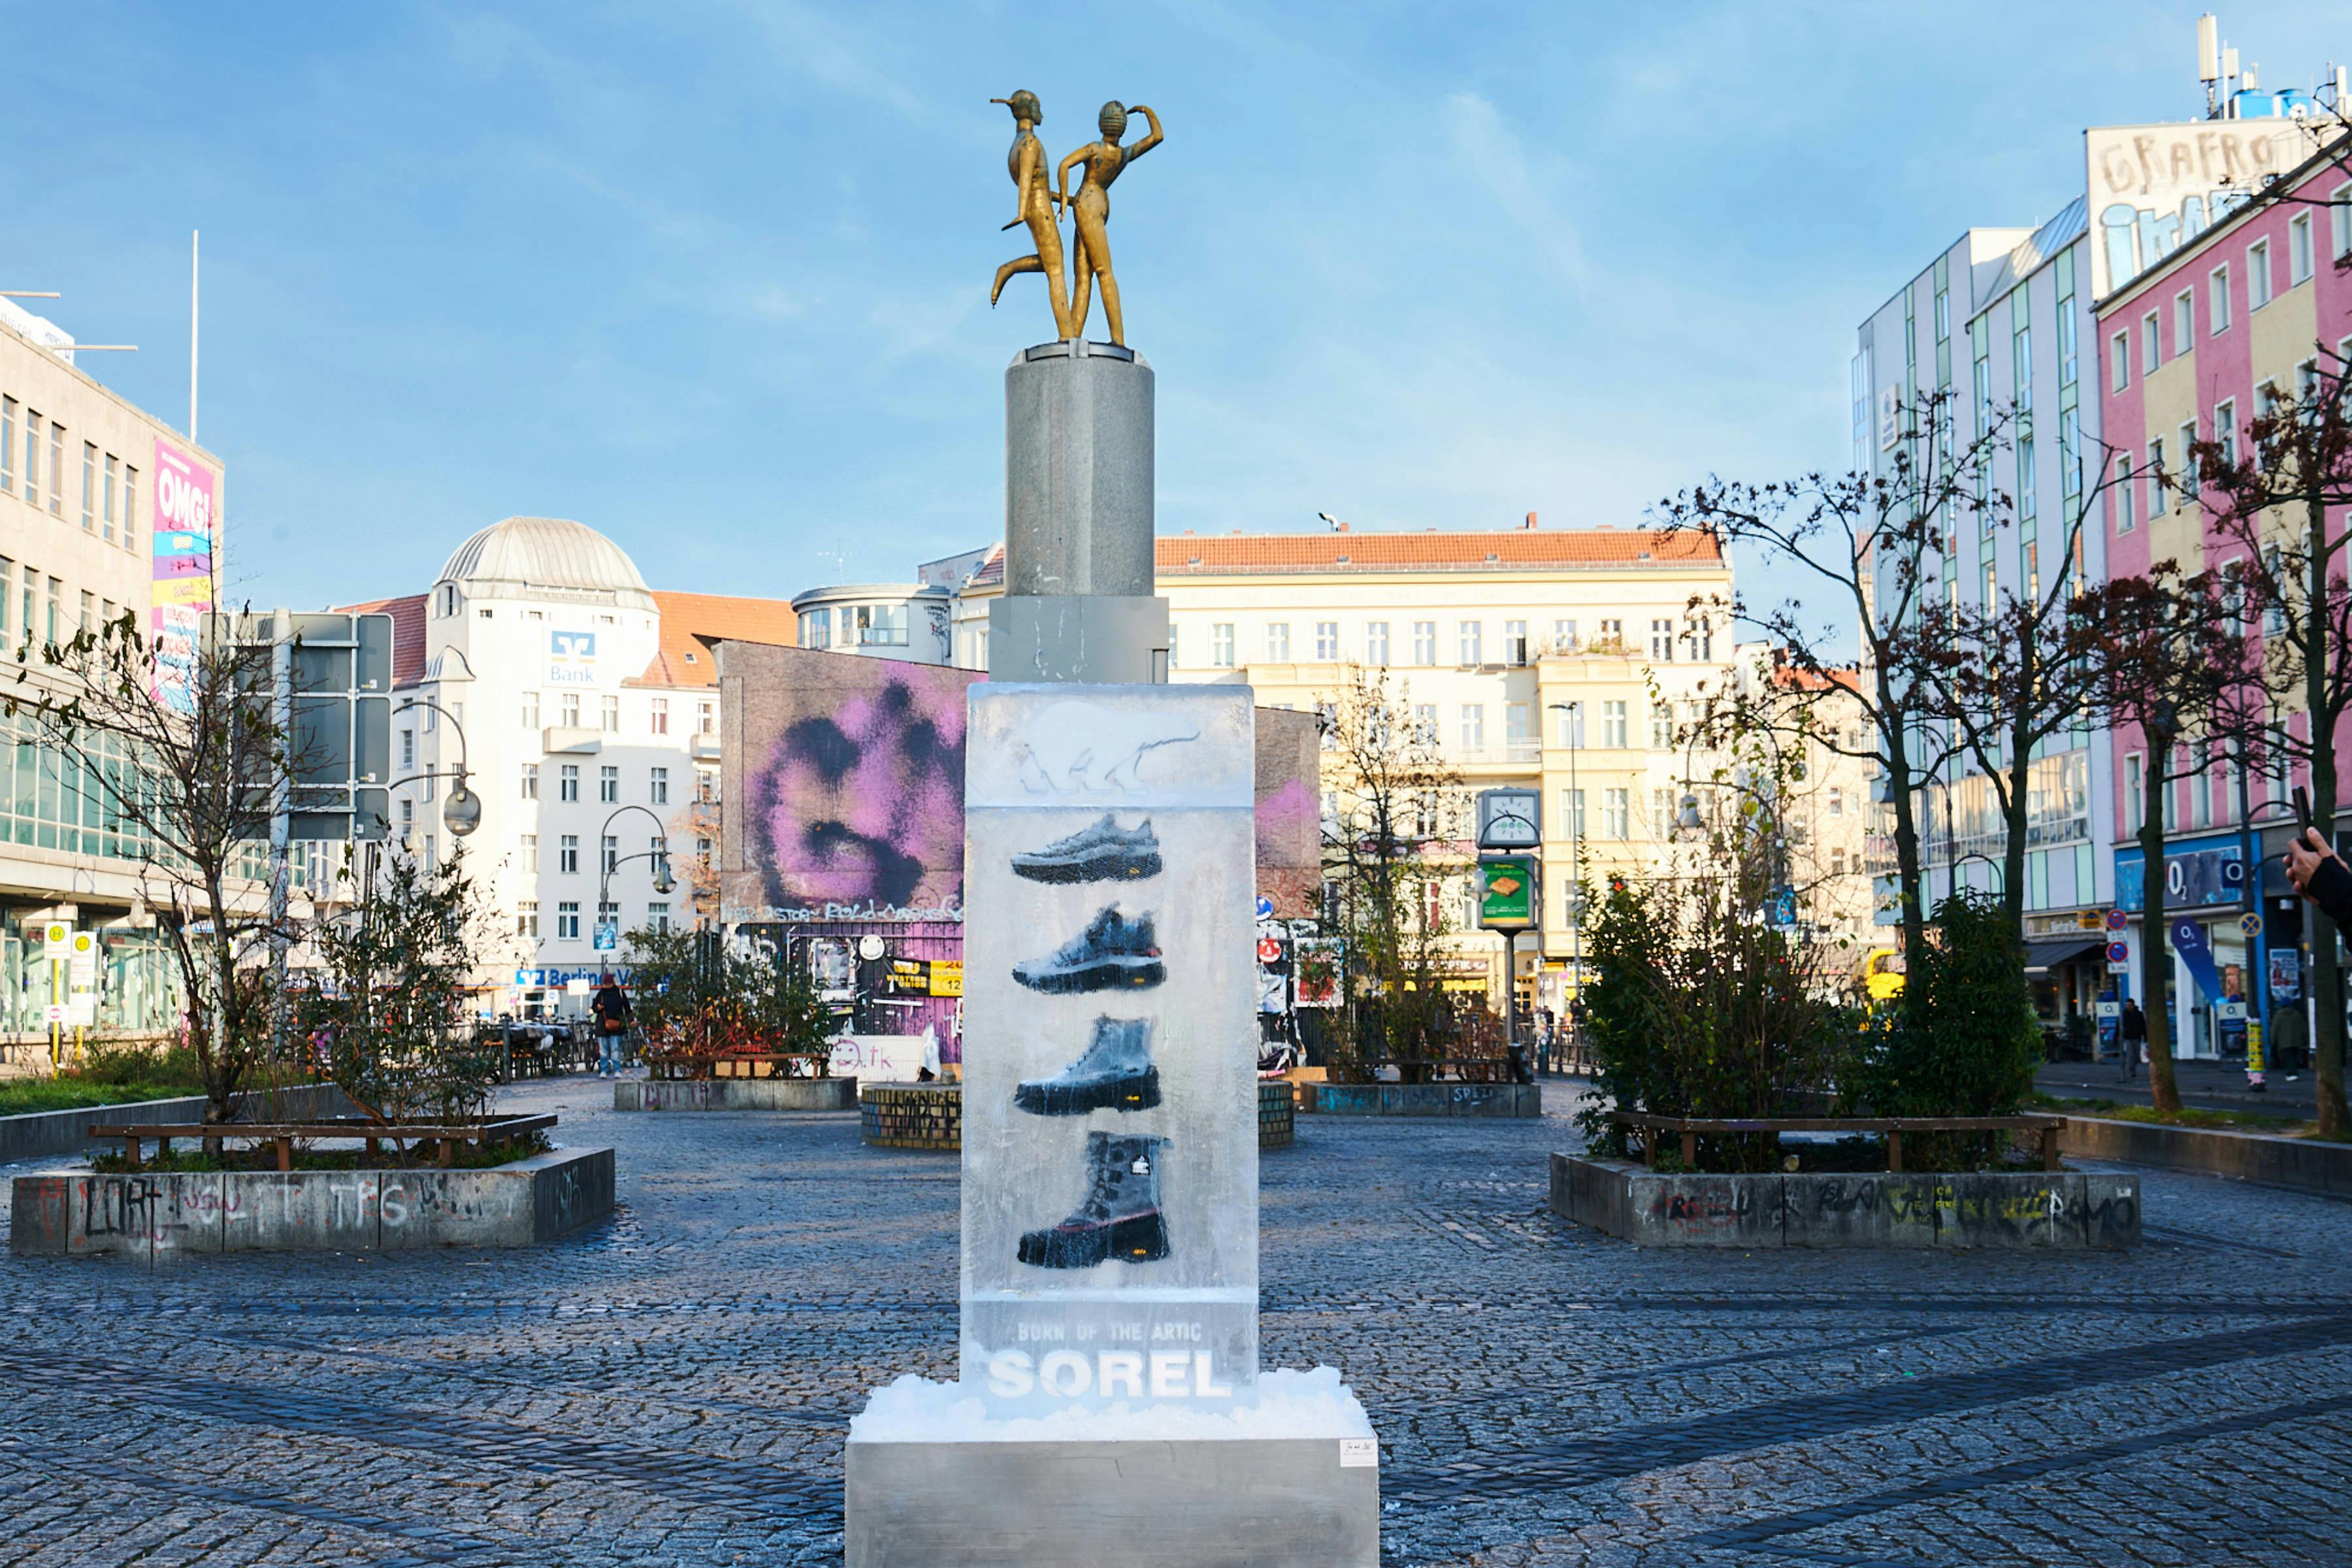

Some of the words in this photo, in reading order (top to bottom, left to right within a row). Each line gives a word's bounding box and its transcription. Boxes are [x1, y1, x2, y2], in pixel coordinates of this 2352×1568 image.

[158, 467, 210, 540] OMG!
[551, 666, 594, 682] Bank
[1017, 1322, 1065, 1341] BORN
[1111, 1323, 1143, 1341] THE
[1151, 1322, 1202, 1342] ARTIC
[988, 1348, 1233, 1399] SOREL
